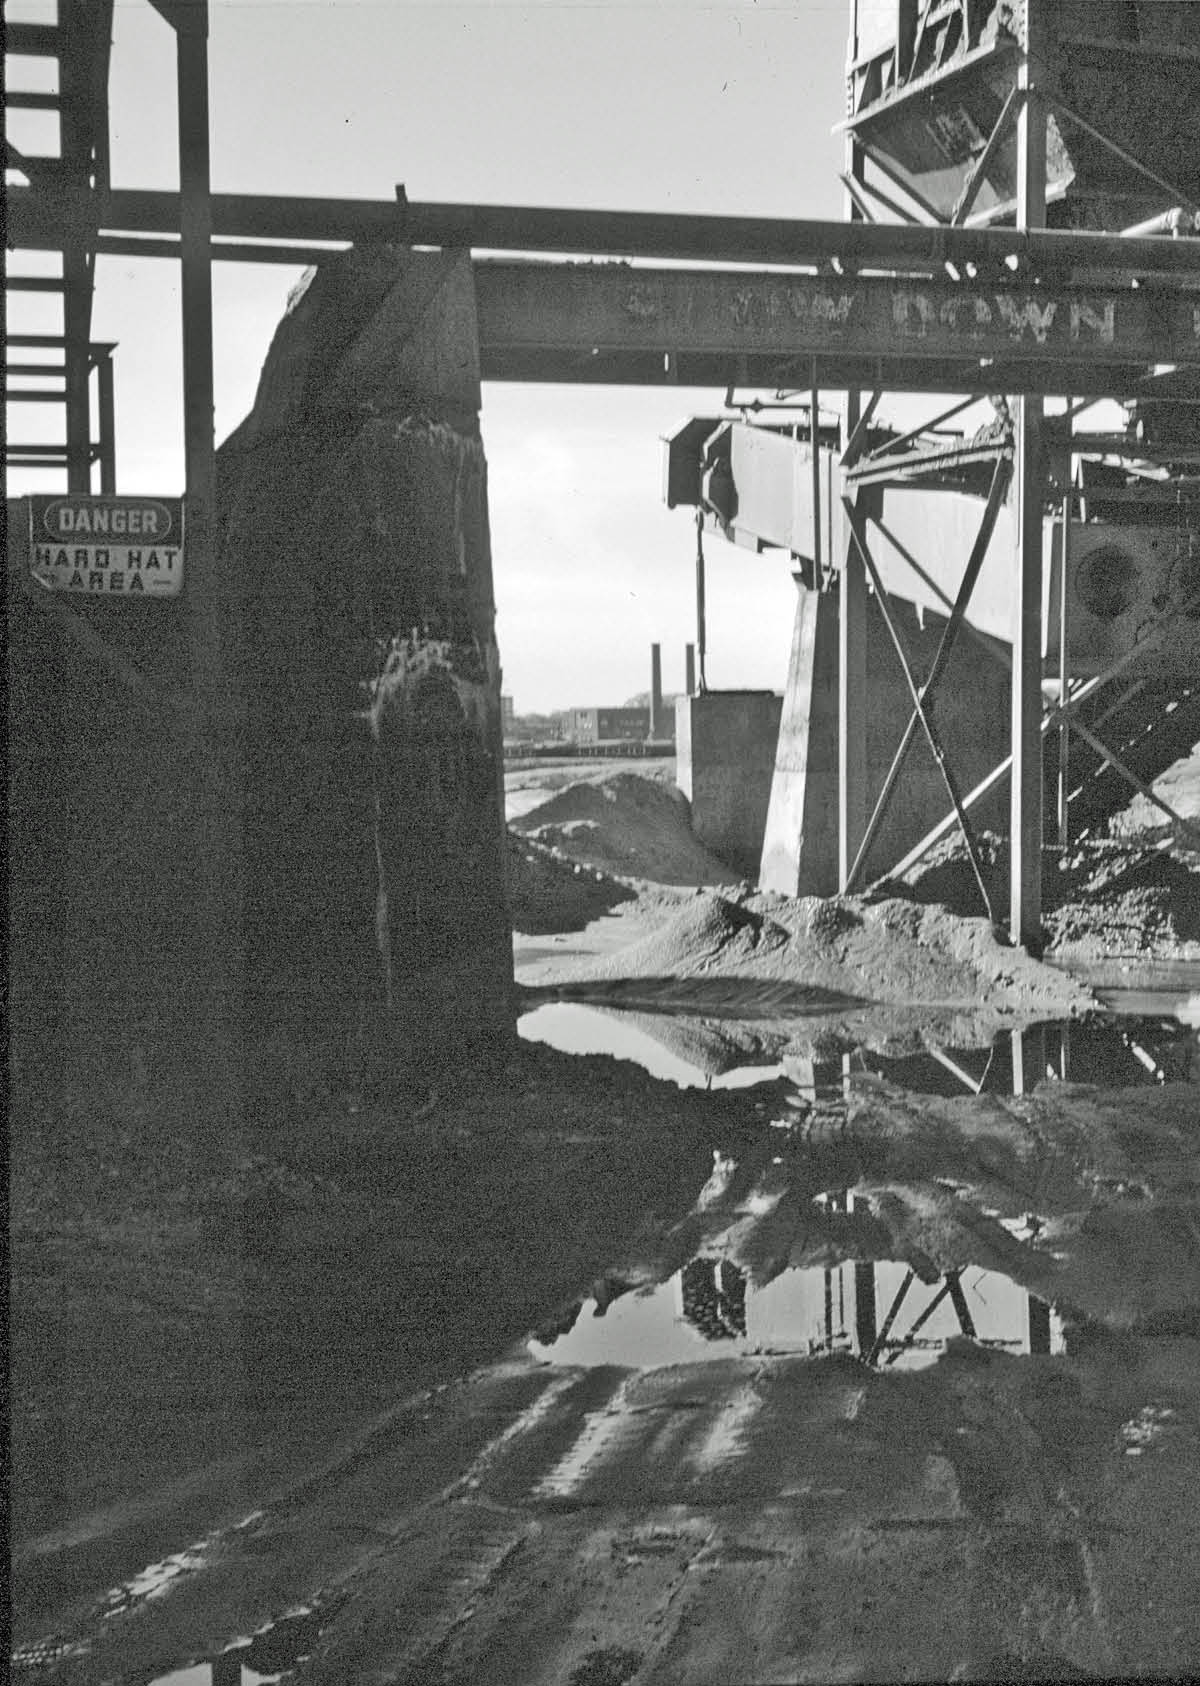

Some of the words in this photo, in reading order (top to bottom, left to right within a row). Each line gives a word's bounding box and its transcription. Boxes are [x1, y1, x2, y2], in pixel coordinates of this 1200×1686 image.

[891, 291, 1115, 344] DOWN
[58, 507, 159, 533] DANGER
[35, 547, 111, 570] HARD
[127, 550, 178, 570] HAT
[69, 570, 145, 592] AREA
